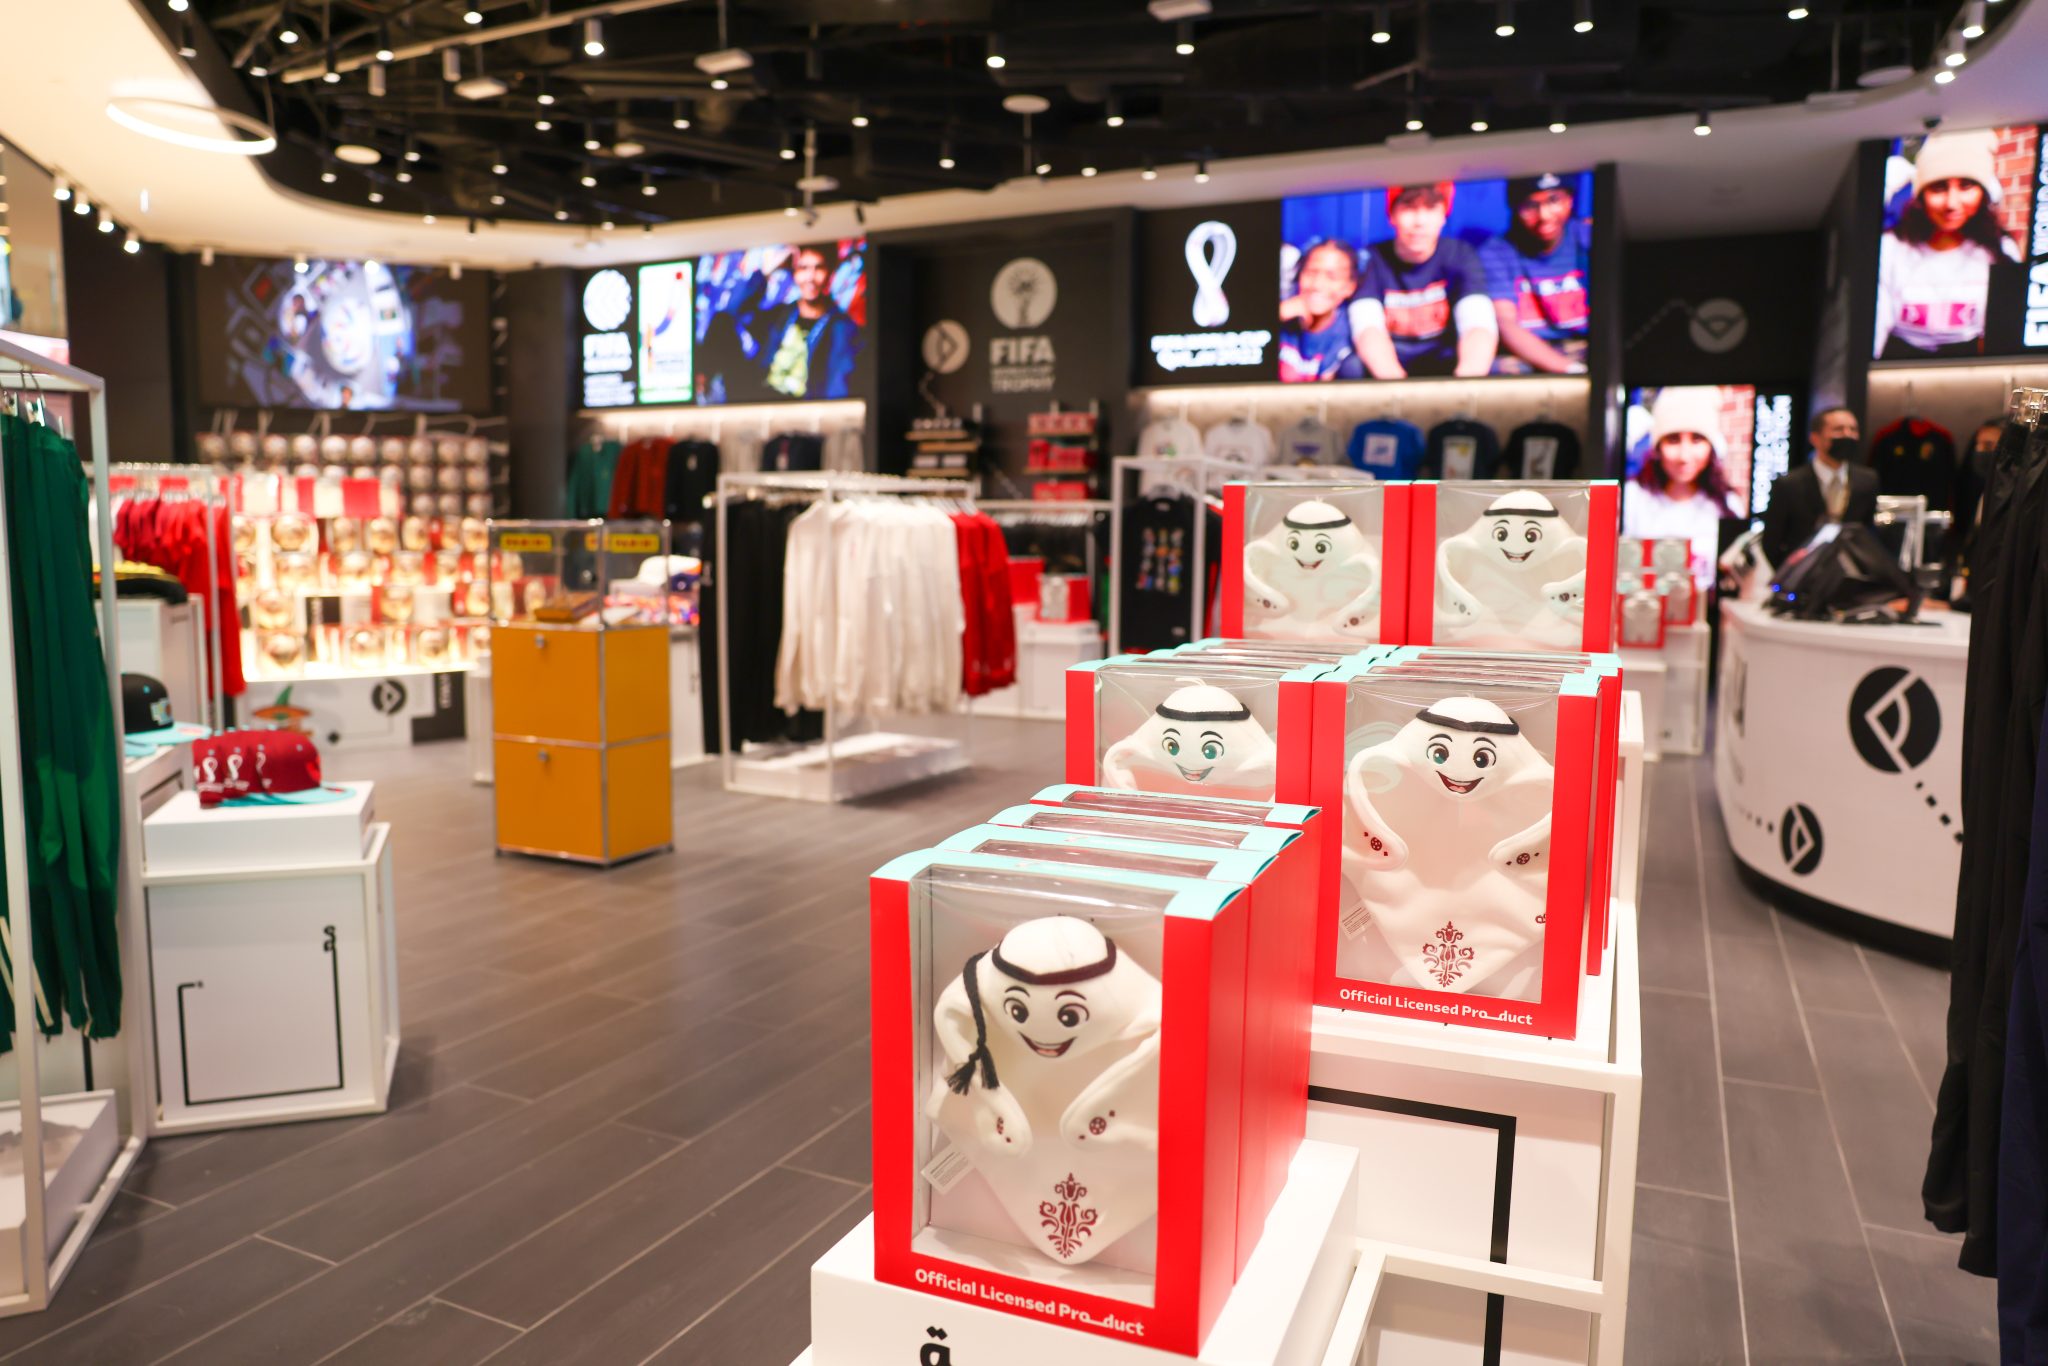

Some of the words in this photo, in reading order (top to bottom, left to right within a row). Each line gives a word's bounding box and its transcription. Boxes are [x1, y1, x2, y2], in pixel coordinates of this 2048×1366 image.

[990, 336, 1056, 364] FIFA
[1340, 988, 1392, 1007] Official
[1395, 997, 1459, 1016] Licensed
[915, 1268, 977, 1296] Official
[980, 1285, 1055, 1315] Licensed
